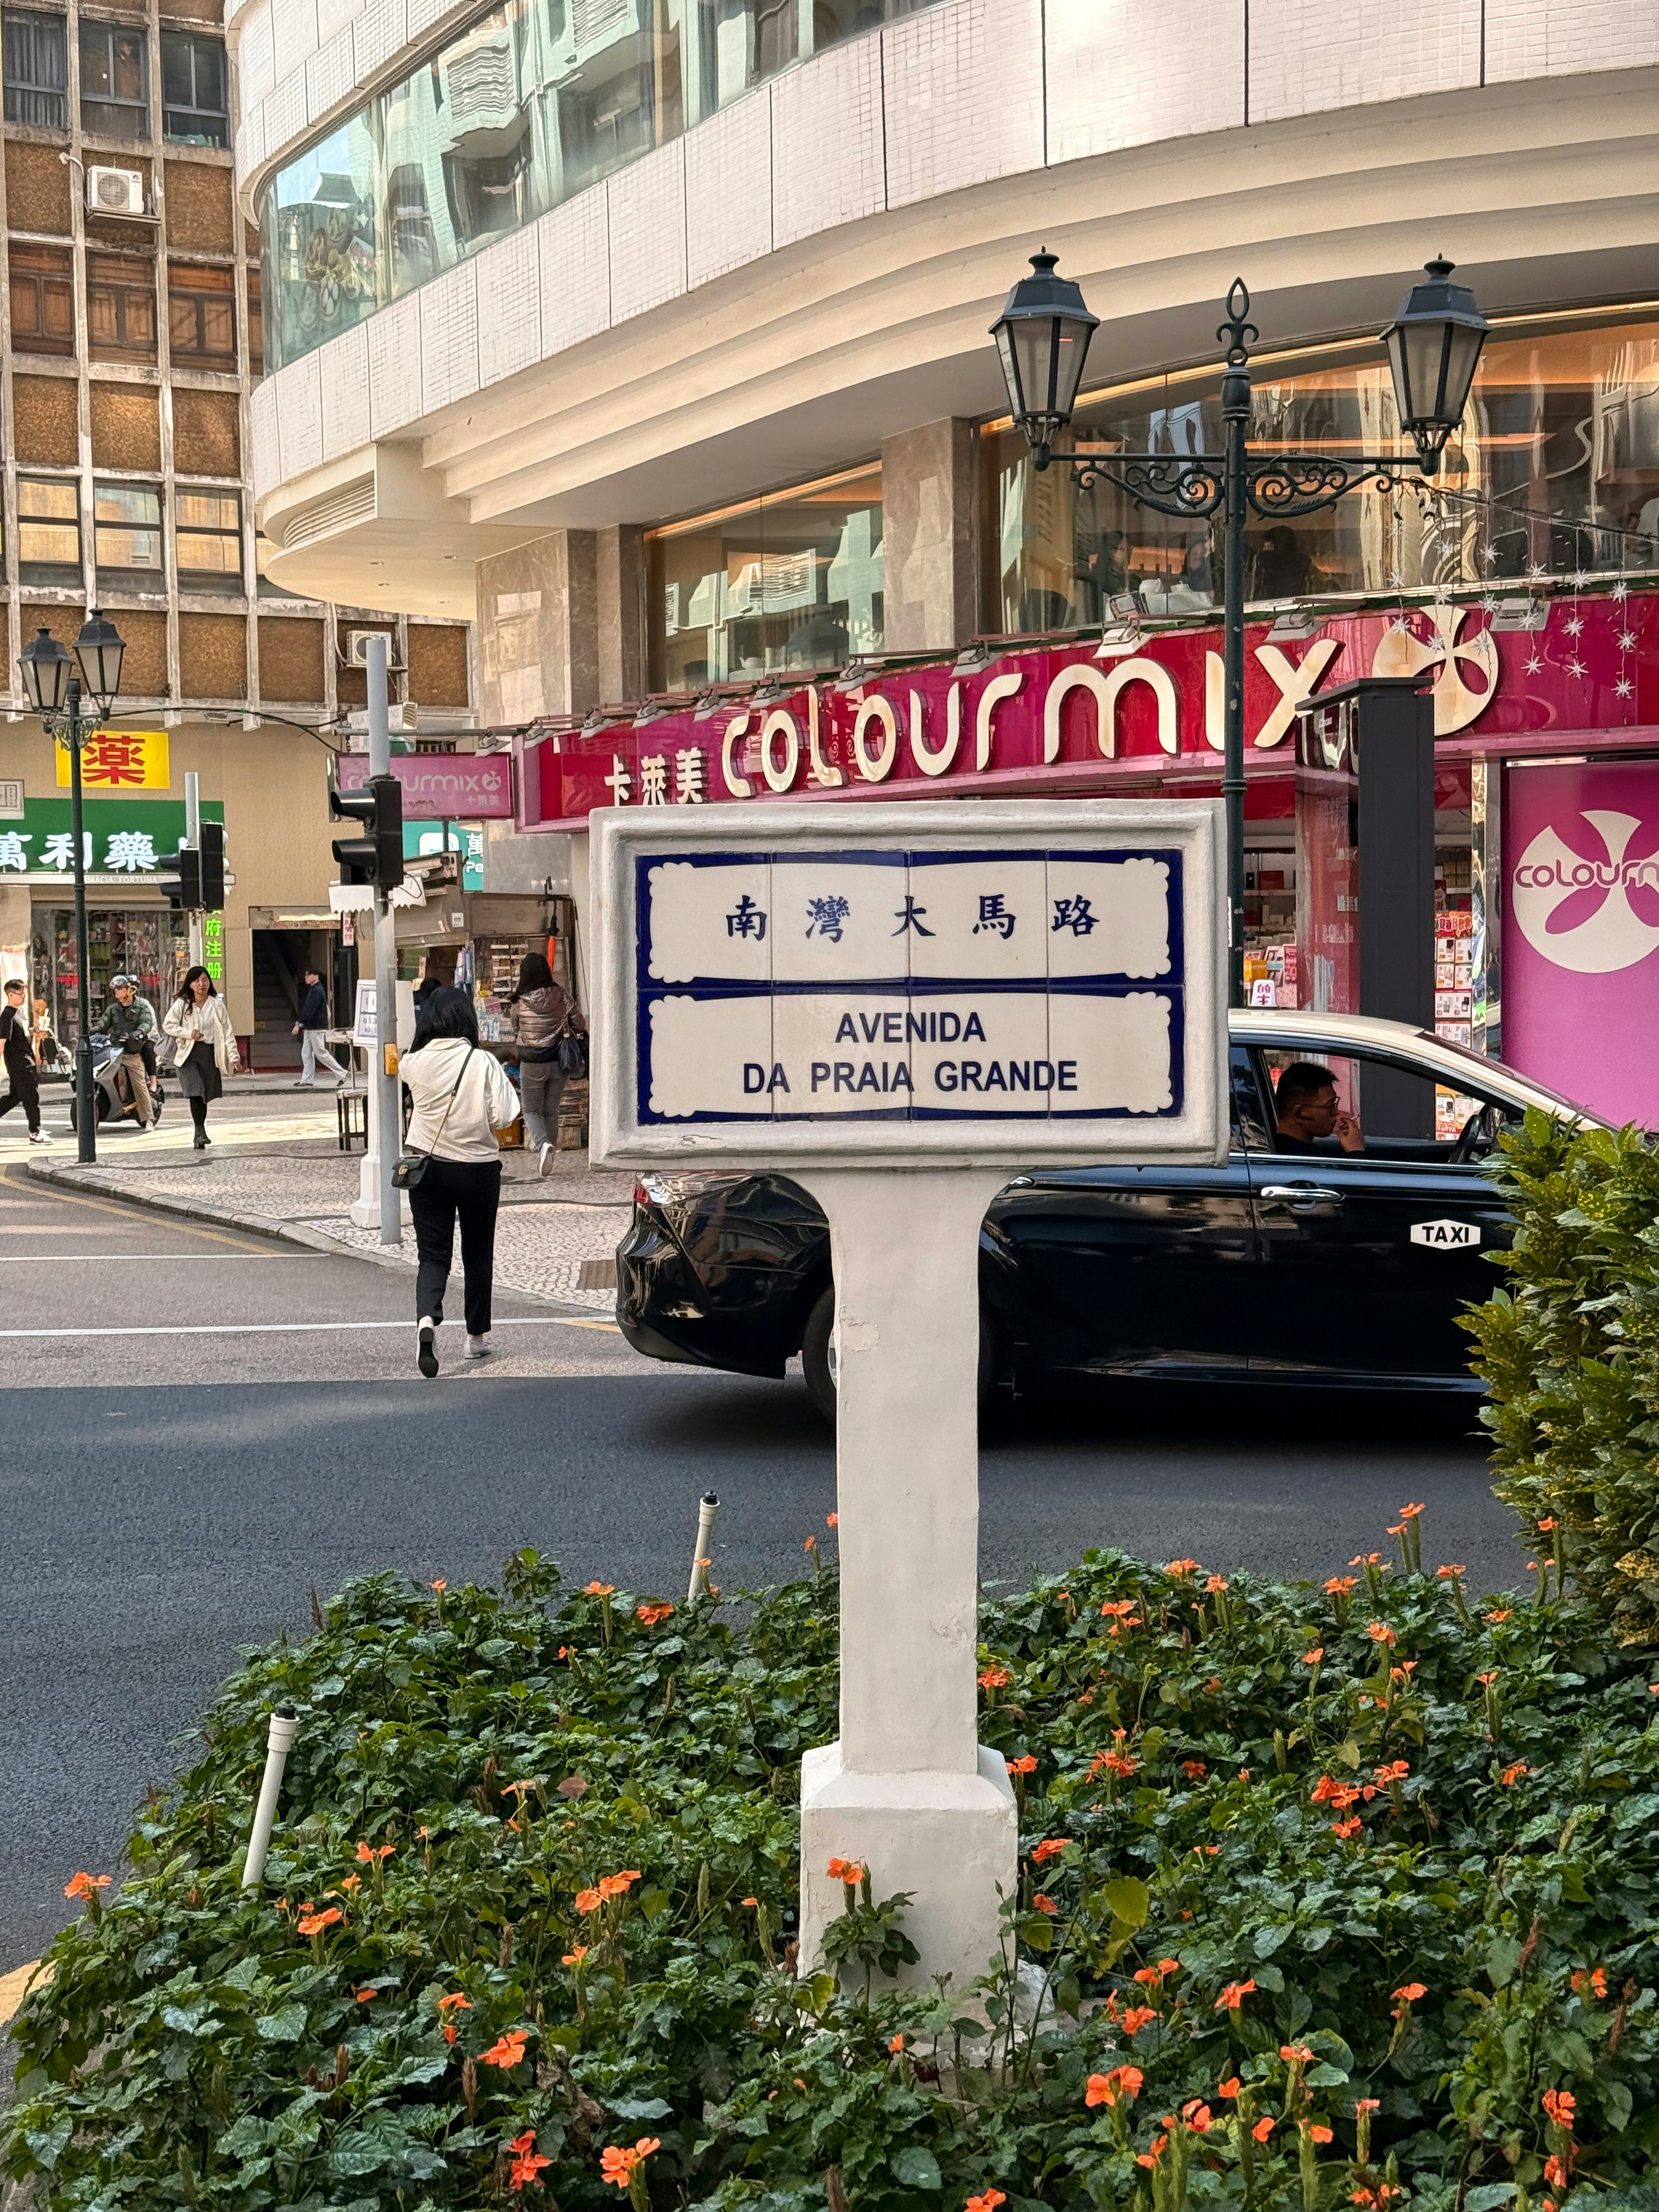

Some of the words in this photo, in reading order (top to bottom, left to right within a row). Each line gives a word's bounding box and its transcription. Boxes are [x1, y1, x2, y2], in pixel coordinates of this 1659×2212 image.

[605, 747, 703, 806] 卡萊美
[0, 831, 189, 871] 萬利藥
[726, 894, 1100, 943] 南灣大馬路
[205, 910, 223, 979] 府注册
[836, 1012, 986, 1043] AVENIDA
[743, 1063, 790, 1093] DA
[811, 1062, 913, 1093] PRAIA
[934, 1060, 1078, 1092] GRANDE
[1421, 1226, 1469, 1243] TAXI
